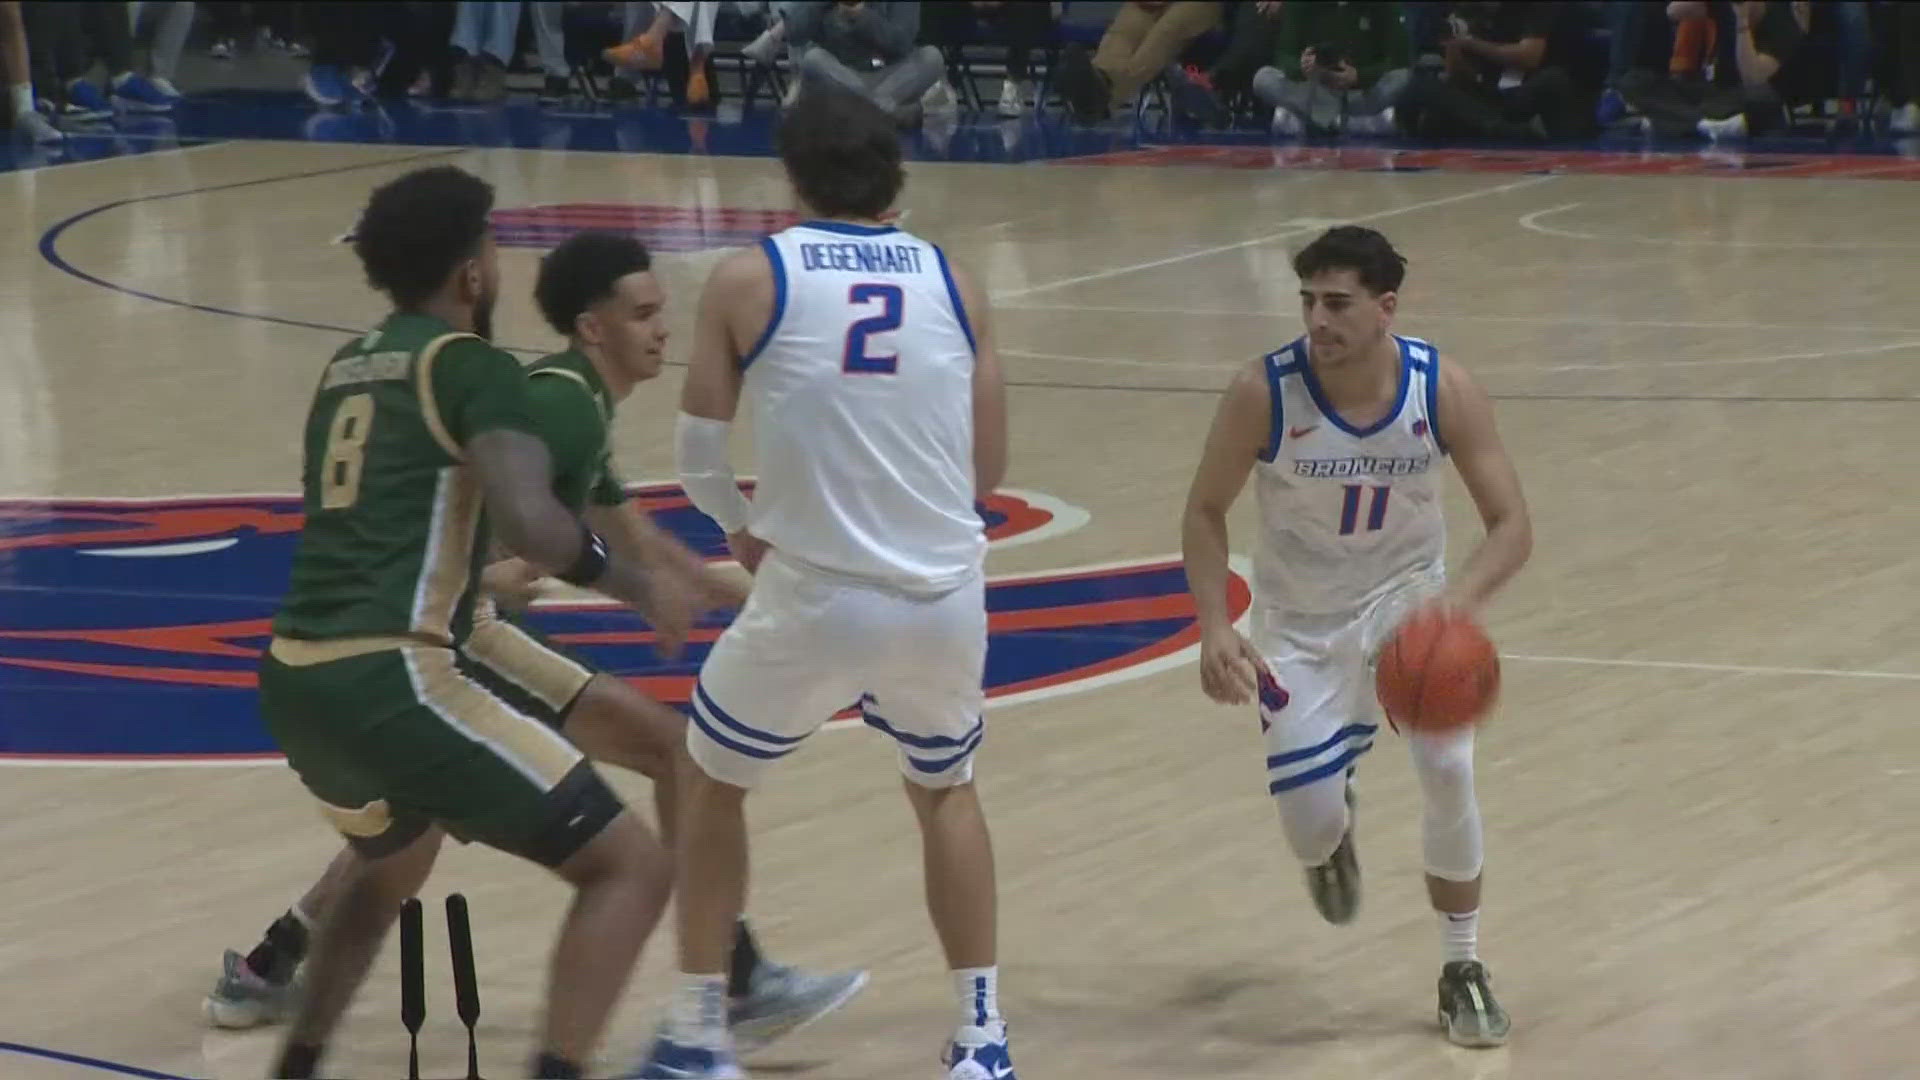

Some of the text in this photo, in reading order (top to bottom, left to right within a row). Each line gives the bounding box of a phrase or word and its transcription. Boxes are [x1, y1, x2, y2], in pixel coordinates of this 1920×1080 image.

[800, 243, 923, 274] DEGENHART
[842, 283, 904, 374] 2
[321, 393, 374, 509] 8
[1294, 456, 1430, 478] BRONCOS
[1339, 484, 1391, 536] 11
